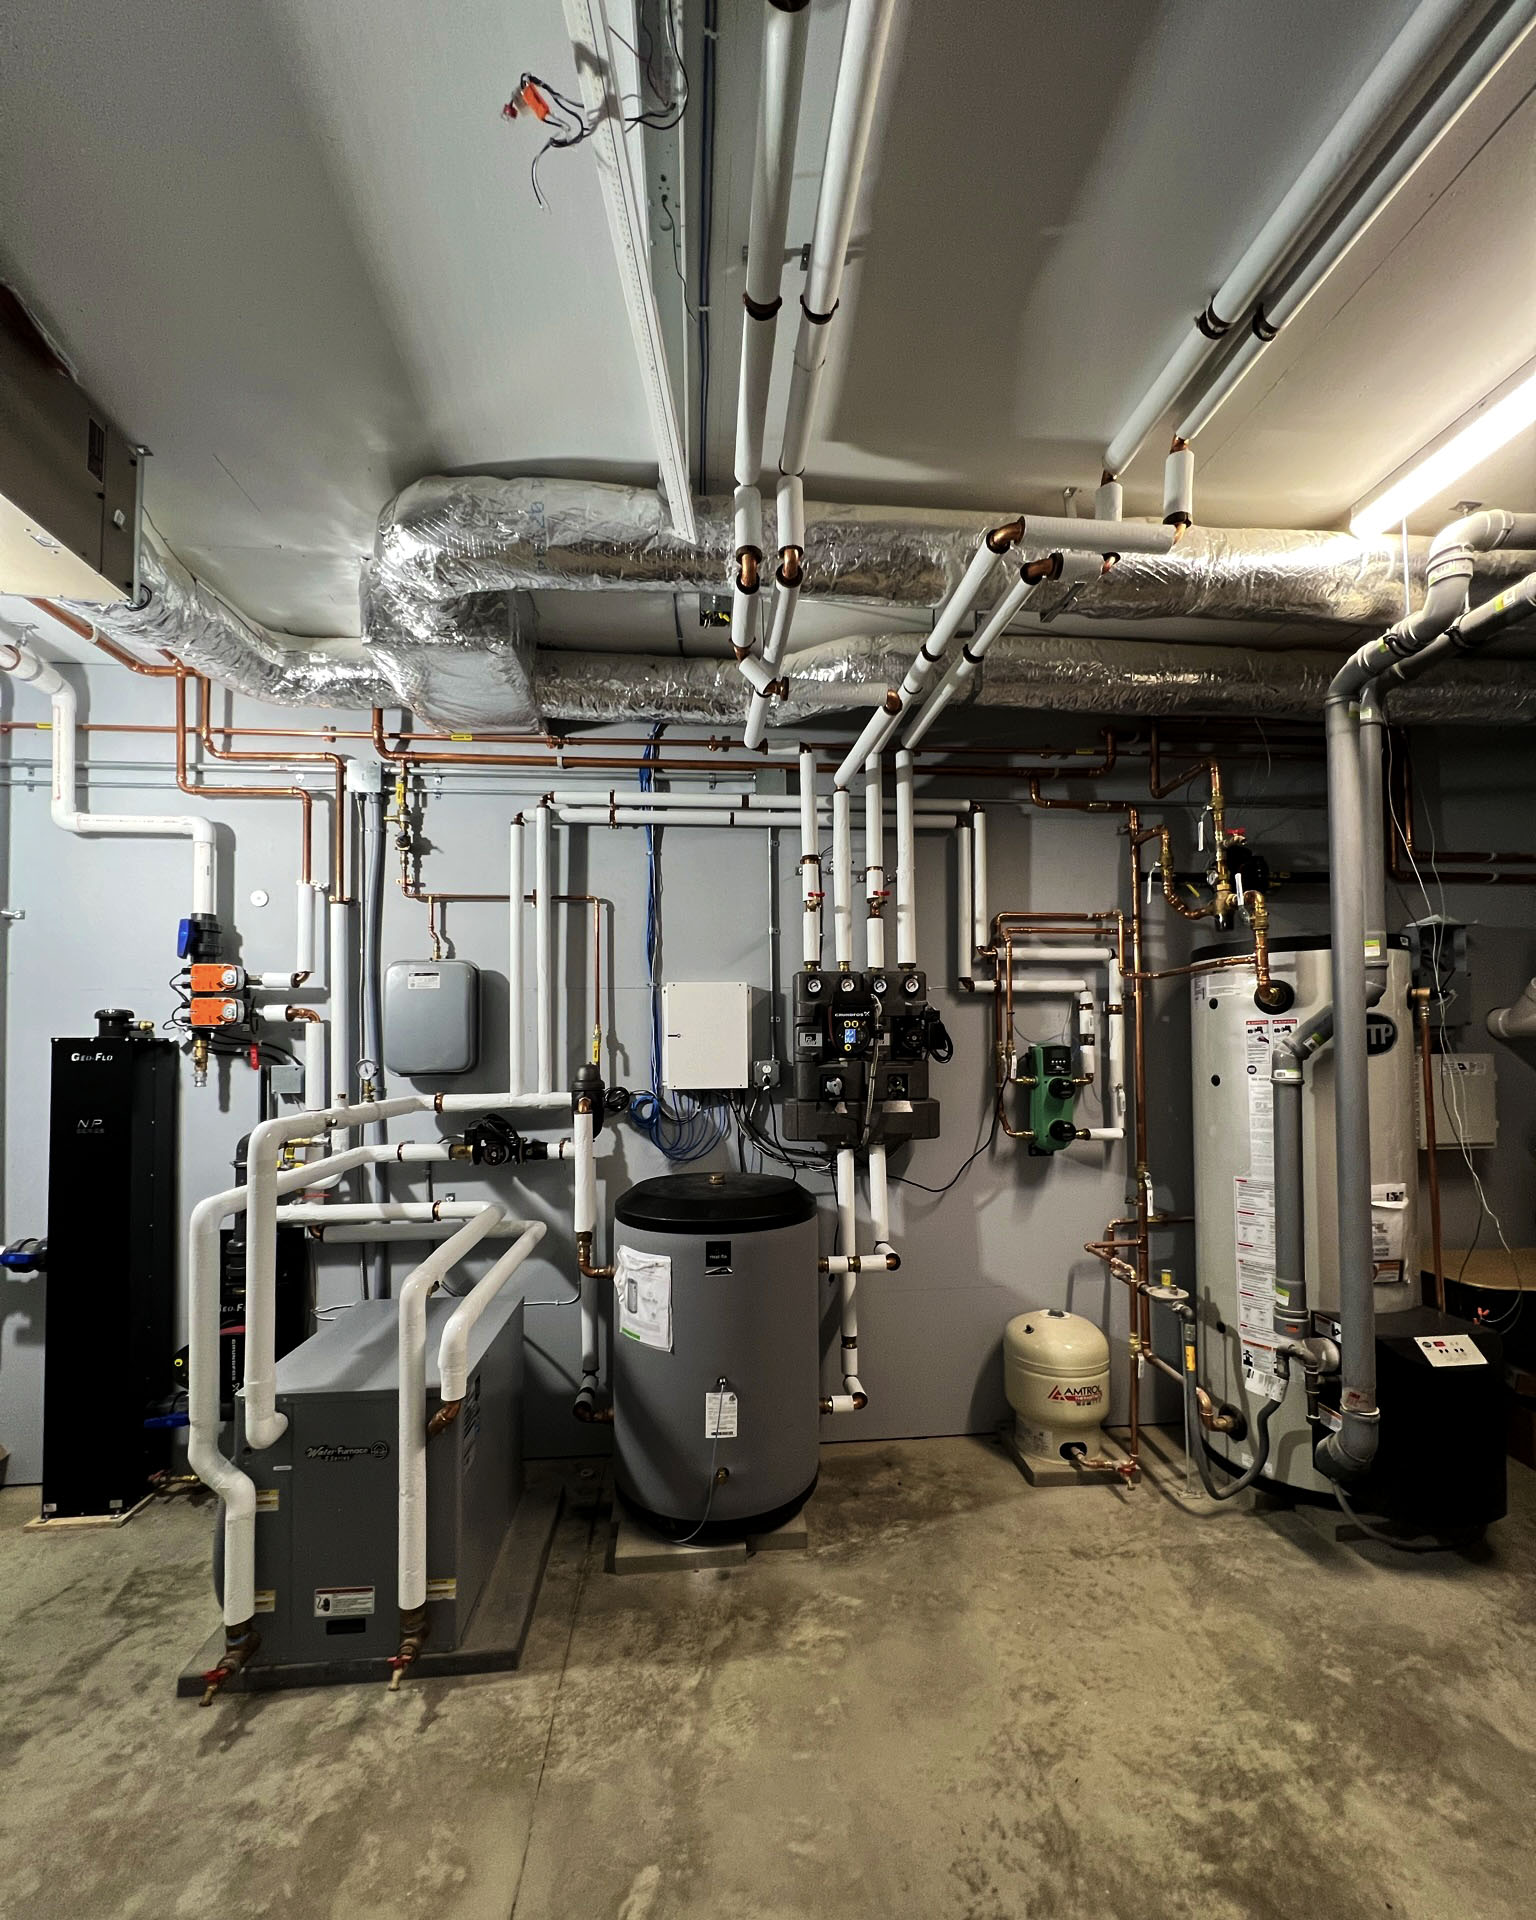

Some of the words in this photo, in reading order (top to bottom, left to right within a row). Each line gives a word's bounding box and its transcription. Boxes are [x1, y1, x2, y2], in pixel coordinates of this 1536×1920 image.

[1367, 1023, 1394, 1045] TP
[78, 1119, 102, 1128] NP
[1064, 1385, 1102, 1396] AMTROL
